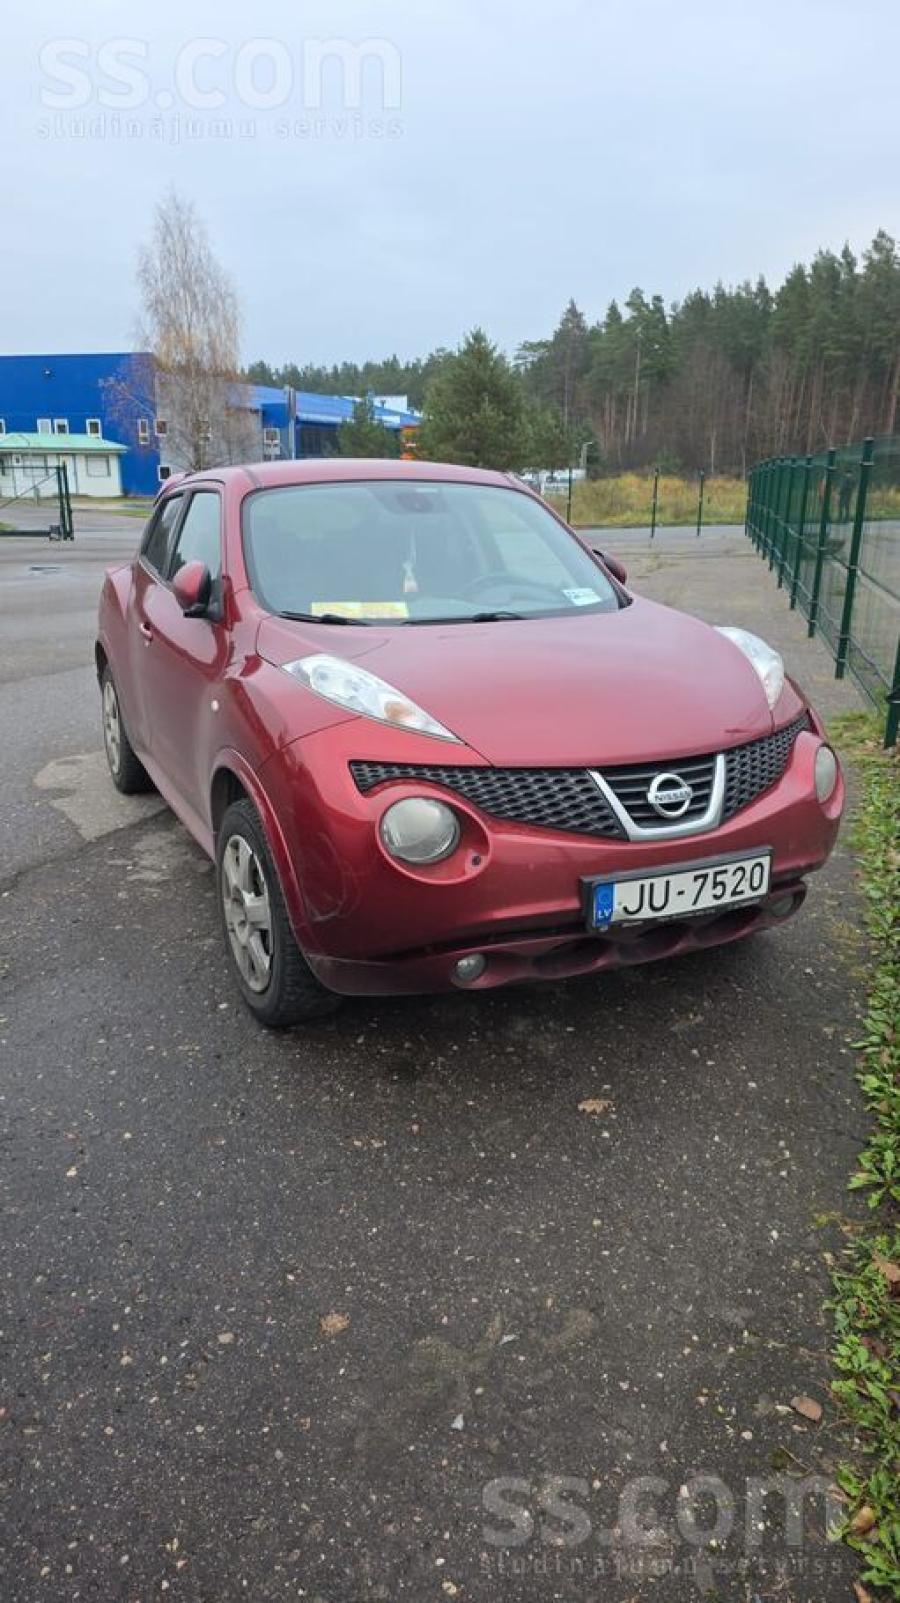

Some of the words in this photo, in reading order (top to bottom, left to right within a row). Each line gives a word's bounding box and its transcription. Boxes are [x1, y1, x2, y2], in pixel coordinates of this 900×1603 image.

[654, 790, 691, 802] NISSAN
[623, 862, 765, 915] JU-7520
[598, 908, 613, 919] LV
